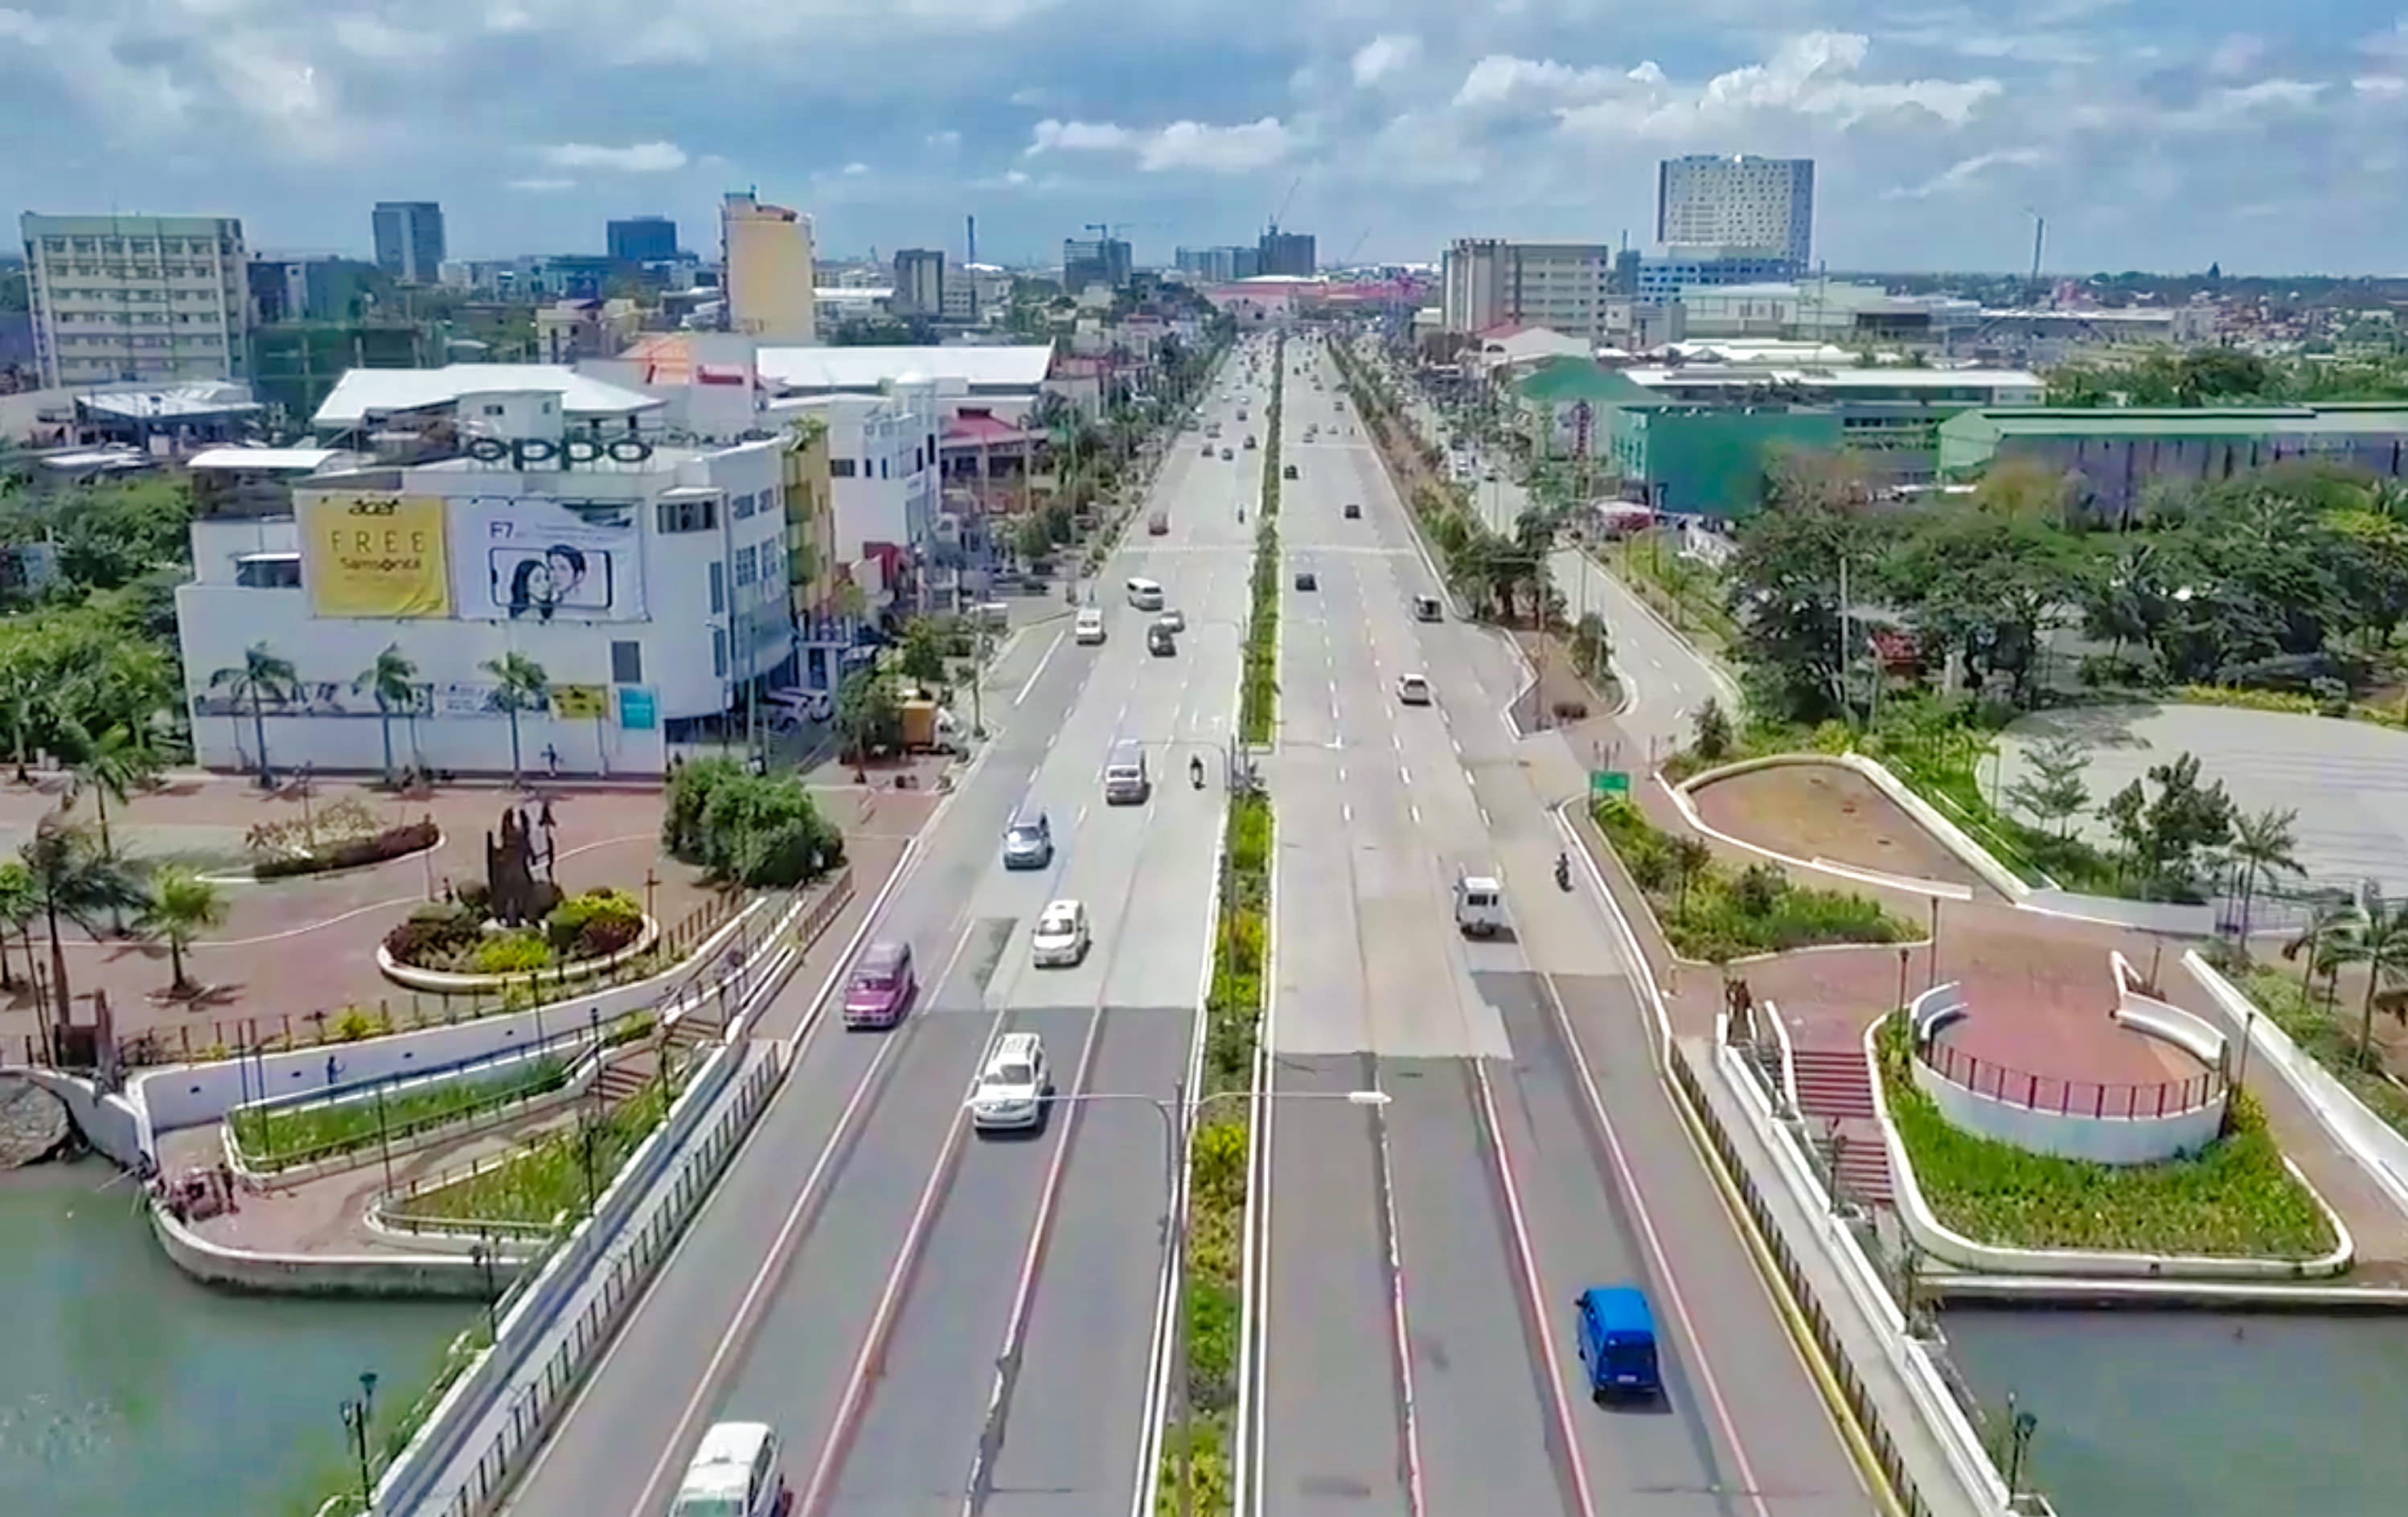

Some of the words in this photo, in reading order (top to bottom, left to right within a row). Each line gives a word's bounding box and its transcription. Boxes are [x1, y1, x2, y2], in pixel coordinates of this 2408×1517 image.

[468, 438, 653, 472] oppo
[348, 500, 397, 515] acer
[490, 522, 514, 539] F7
[331, 530, 425, 553] FREE
